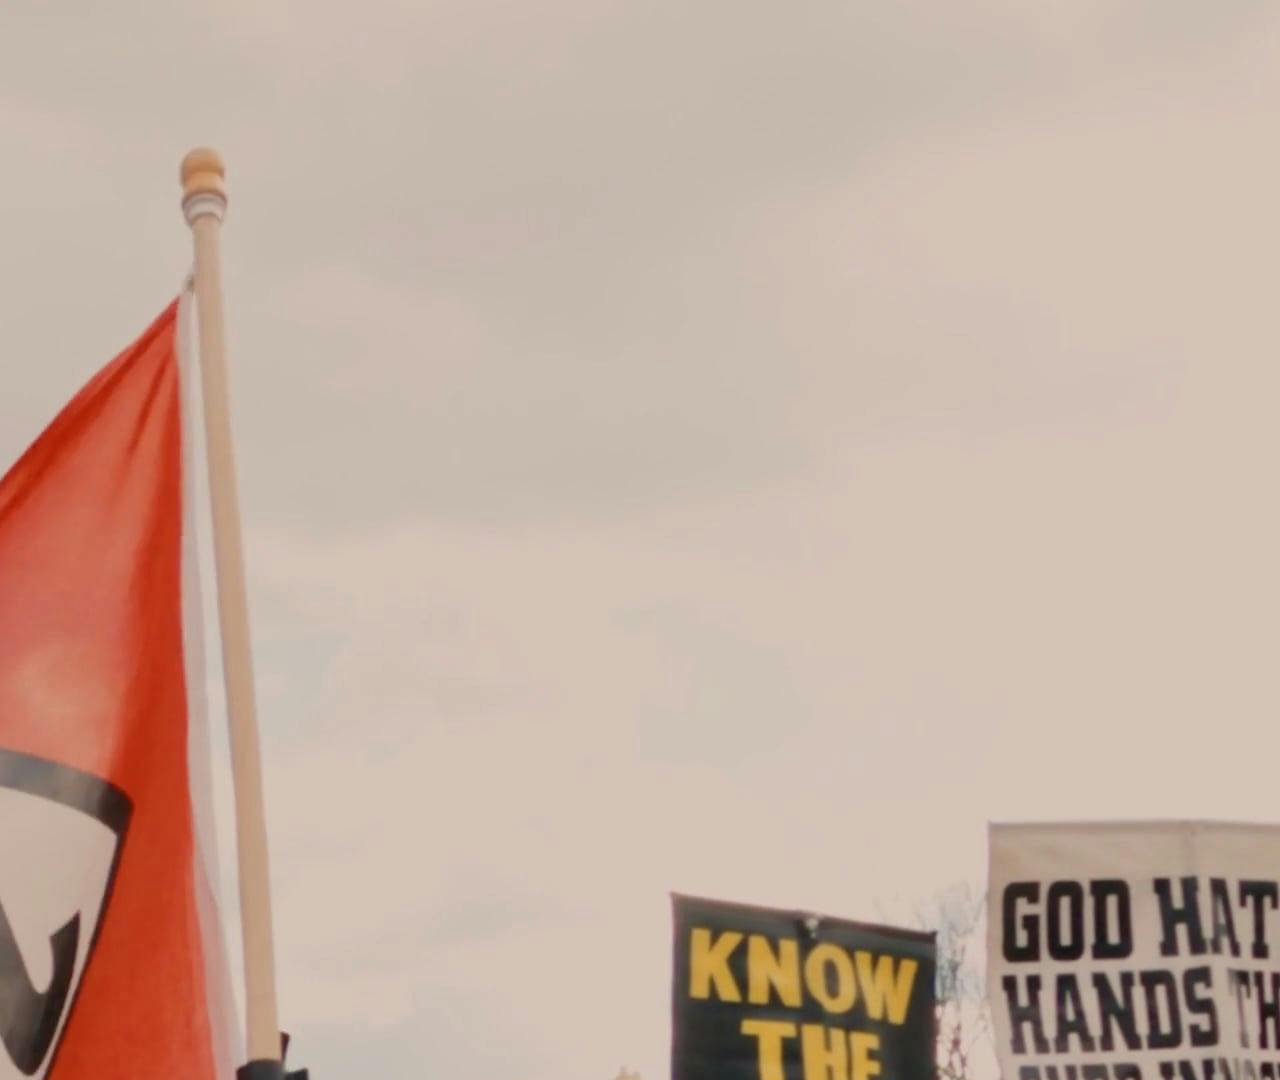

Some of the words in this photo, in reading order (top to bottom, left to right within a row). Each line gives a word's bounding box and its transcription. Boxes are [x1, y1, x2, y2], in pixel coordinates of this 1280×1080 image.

[1003, 879, 1133, 962] GOD
[689, 927, 918, 1025] KNOW
[1002, 966, 1219, 1054] HANDS
